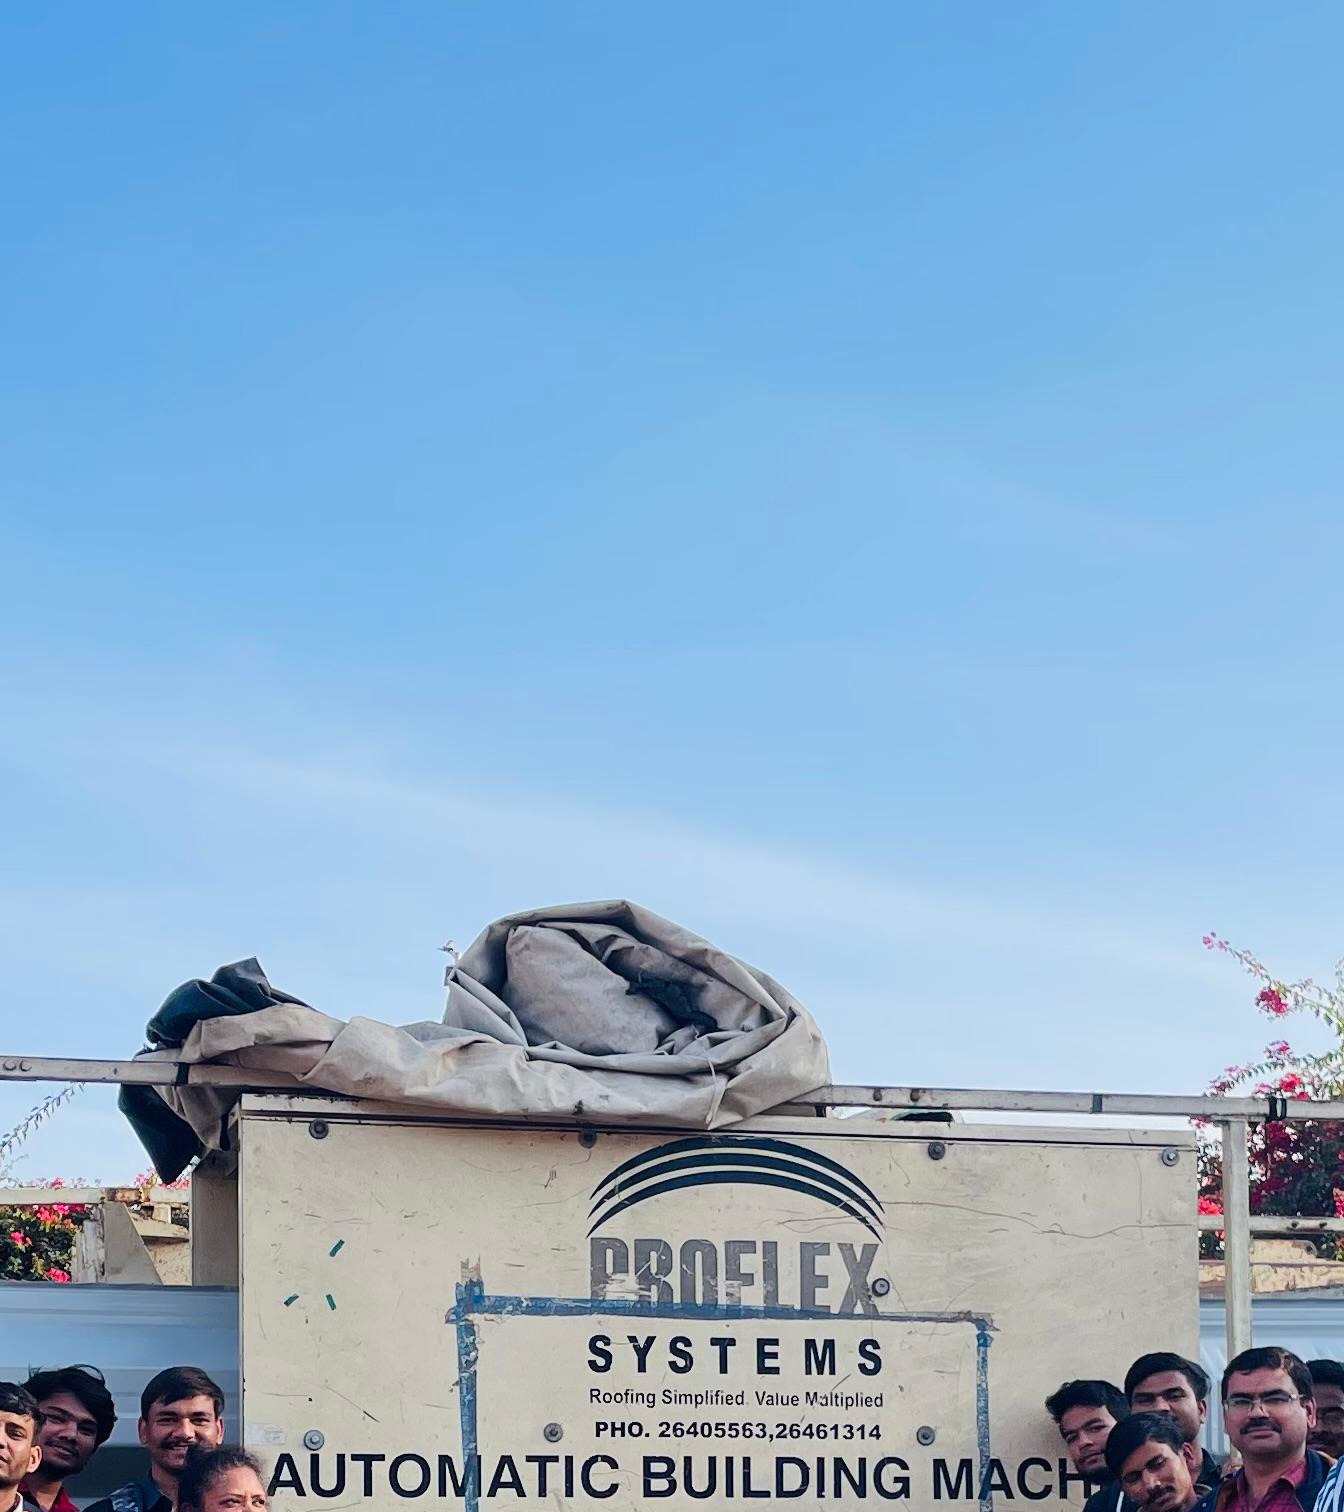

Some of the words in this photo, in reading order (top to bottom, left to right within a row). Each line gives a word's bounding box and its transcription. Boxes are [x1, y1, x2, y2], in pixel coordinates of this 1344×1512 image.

[590, 1237, 881, 1319] PROFLEX
[588, 1334, 882, 1375] SYSTEMS
[589, 1388, 656, 1408] Roofing
[755, 1391, 799, 1407] Value
[595, 1422, 650, 1438] PHO.
[658, 1422, 882, 1443] 26405563,26461314
[267, 1452, 619, 1499] AUTOMATIC
[642, 1454, 910, 1500] BUILDING
